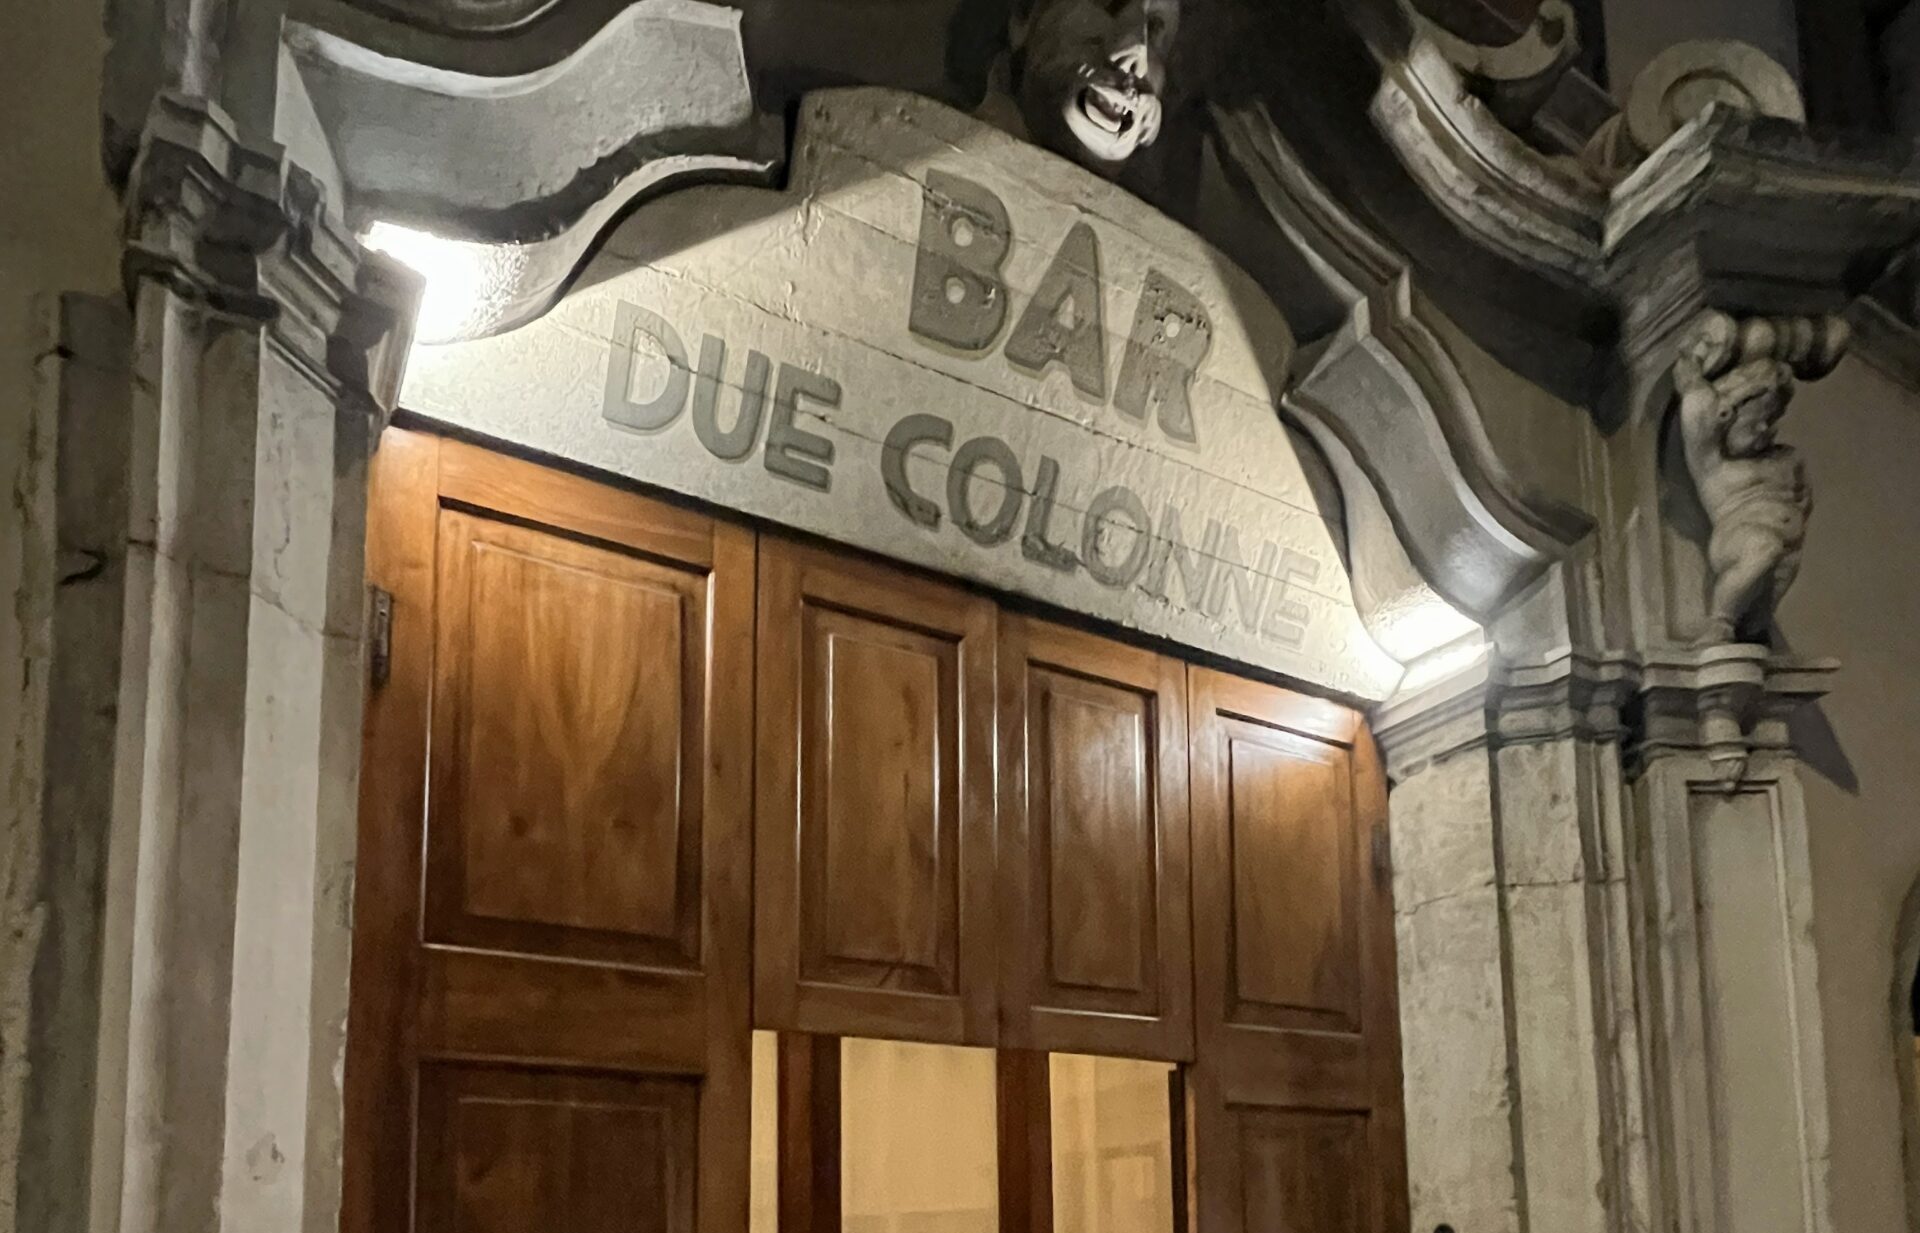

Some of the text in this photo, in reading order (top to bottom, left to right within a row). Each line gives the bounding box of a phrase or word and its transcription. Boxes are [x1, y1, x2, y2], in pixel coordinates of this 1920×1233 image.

[908, 167, 1212, 446] BAR
[602, 300, 1321, 648] DUE COLONNE
